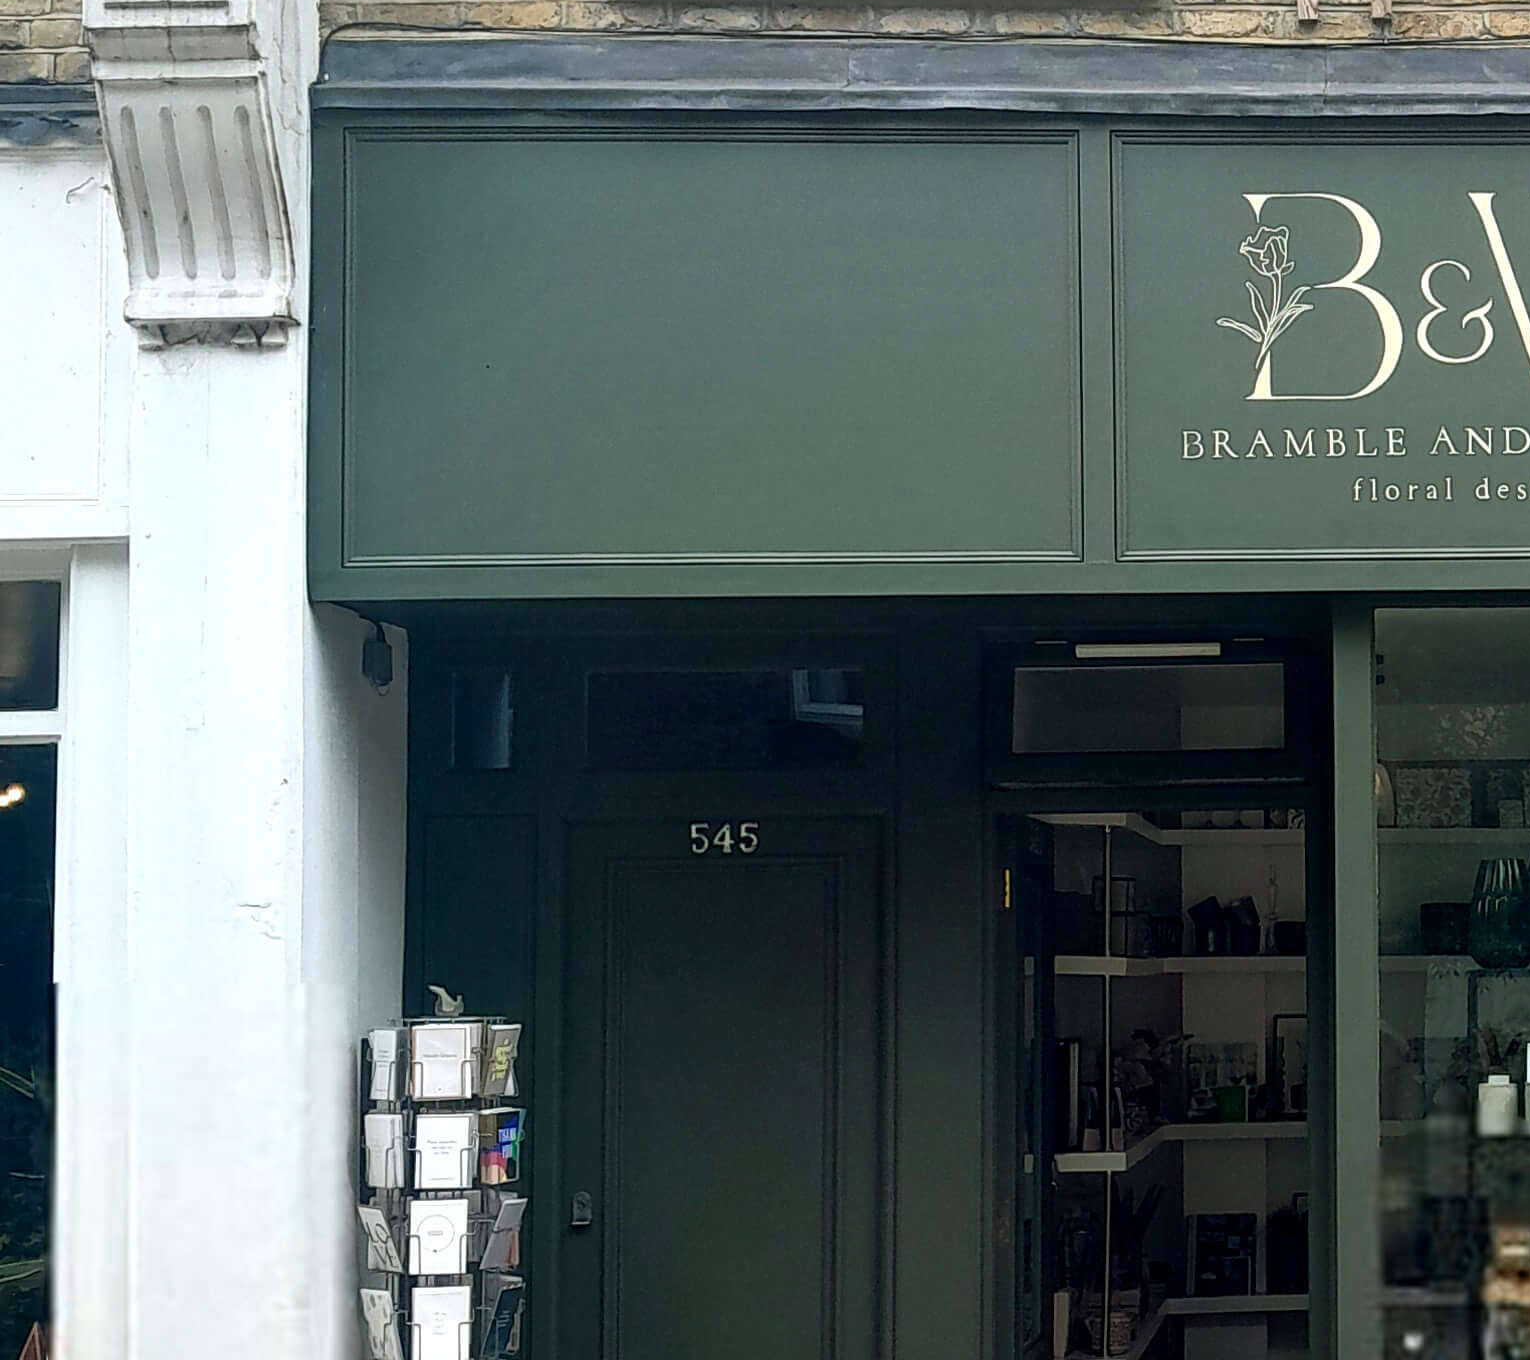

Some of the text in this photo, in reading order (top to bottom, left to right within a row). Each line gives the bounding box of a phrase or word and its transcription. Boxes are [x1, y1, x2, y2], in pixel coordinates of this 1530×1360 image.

[1181, 428, 1407, 460] BRAMBLE
[1352, 477, 1454, 501] floral
[690, 823, 759, 854] 545
